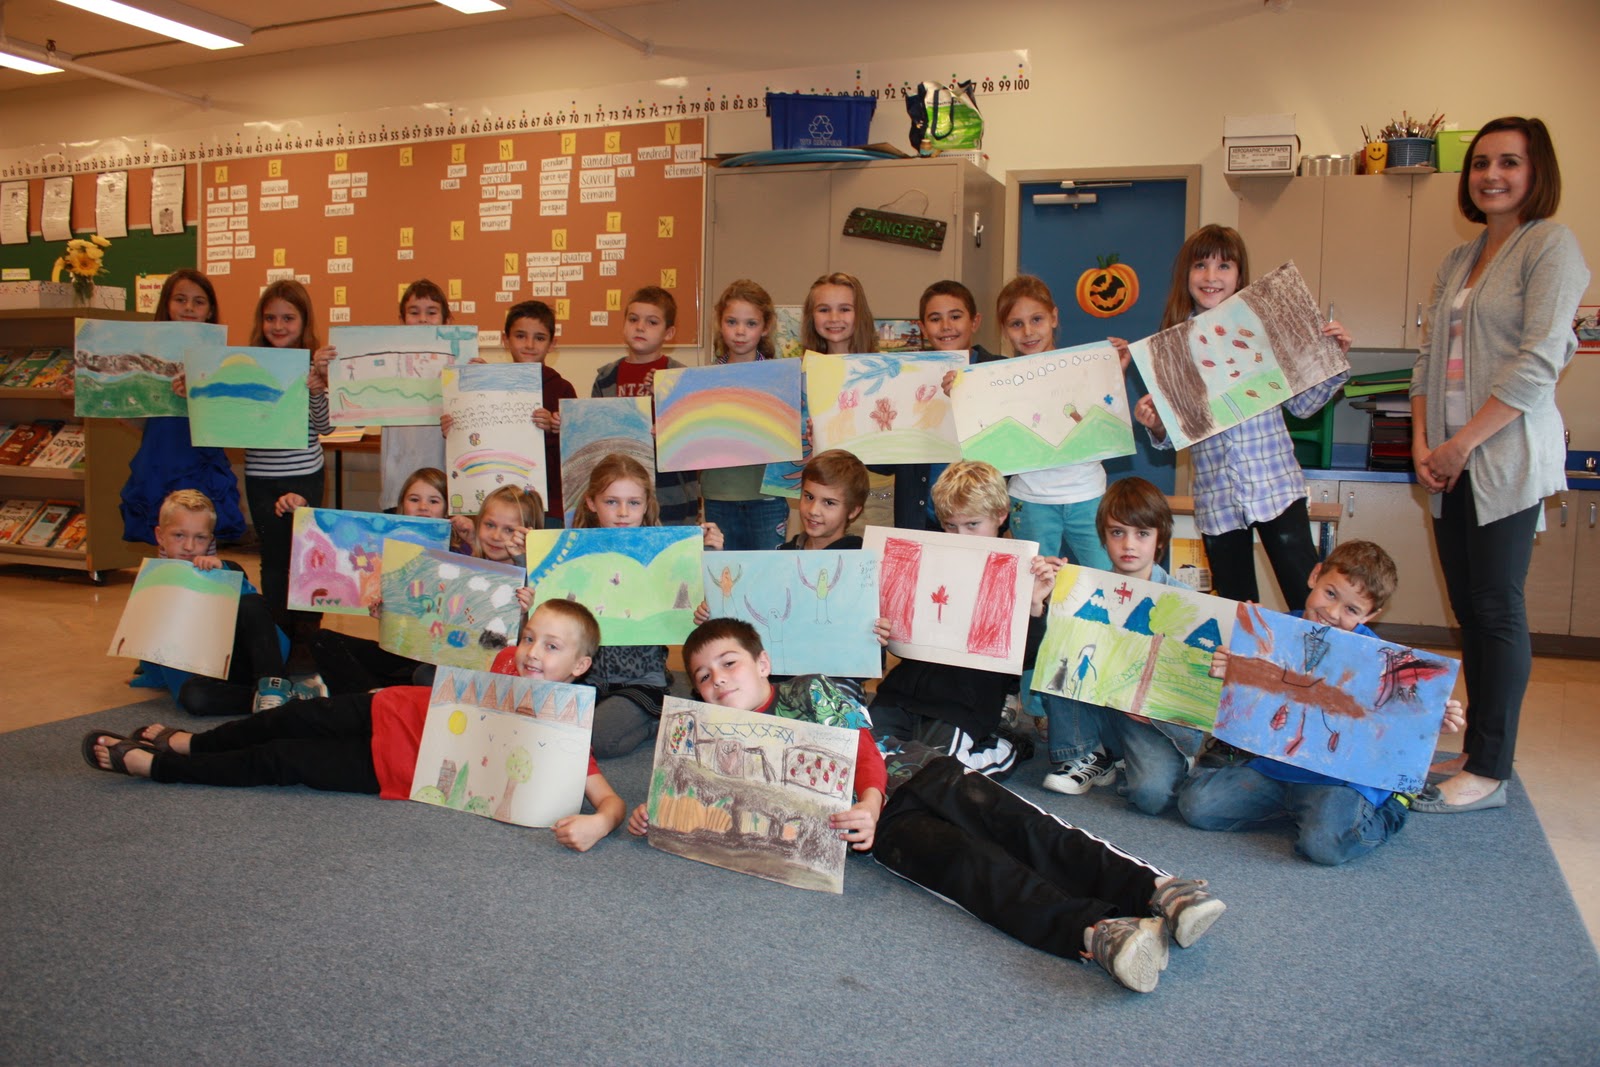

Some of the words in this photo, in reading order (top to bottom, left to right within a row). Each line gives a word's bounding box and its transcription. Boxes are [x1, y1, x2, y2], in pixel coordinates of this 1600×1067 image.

[336, 137, 344, 145] 50
[348, 136, 355, 144] 51
[358, 135, 366, 143] 52
[369, 134, 376, 142] 53
[380, 133, 388, 141] 54
[391, 132, 399, 140] 55
[402, 130, 410, 139] 56
[412, 129, 421, 138] 57
[424, 128, 432, 137] 58
[436, 127, 444, 136] 59
[447, 126, 456, 135] 60
[460, 125, 467, 134] 61
[471, 124, 480, 133] 62
[483, 123, 492, 132] 63
[495, 121, 503, 130] 64
[506, 120, 515, 129] 65
[519, 119, 528, 128] 66
[531, 118, 540, 127] 67
[544, 116, 553, 126] 68
[556, 115, 565, 124] 69
[569, 114, 579, 123] 70
[584, 114, 591, 123] 71
[596, 112, 605, 122] 72
[609, 111, 618, 120] 73
[622, 110, 632, 119] 74
[636, 108, 645, 118] 75
[649, 107, 659, 117] 76
[663, 105, 672, 115] 77
[676, 104, 686, 114] 78
[690, 102, 700, 113] 79
[704, 101, 715, 112] 80
[720, 100, 728, 111] 81
[733, 99, 743, 110] 82
[747, 98, 758, 109] 83
[885, 88, 895, 99] 92
[982, 81, 994, 92] 98
[999, 80, 1011, 91] 99
[1014, 79, 1029, 90] 100
[668, 127, 677, 140] V
[564, 137, 571, 152] P
[608, 136, 616, 149] S
[454, 148, 461, 161] J
[501, 144, 510, 157] M
[337, 157, 343, 167] D
[402, 151, 409, 164] G
[218, 169, 224, 180] A
[271, 163, 278, 175] B
[610, 216, 618, 229] T
[454, 226, 460, 237] K
[862, 218, 935, 242] DANGER!
[402, 232, 410, 243] H
[554, 232, 564, 247] Q
[337, 241, 344, 253] E
[506, 257, 514, 271] N
[336, 290, 344, 302] F
[450, 284, 459, 296] L
[610, 293, 617, 306] U
[558, 302, 565, 315] R
